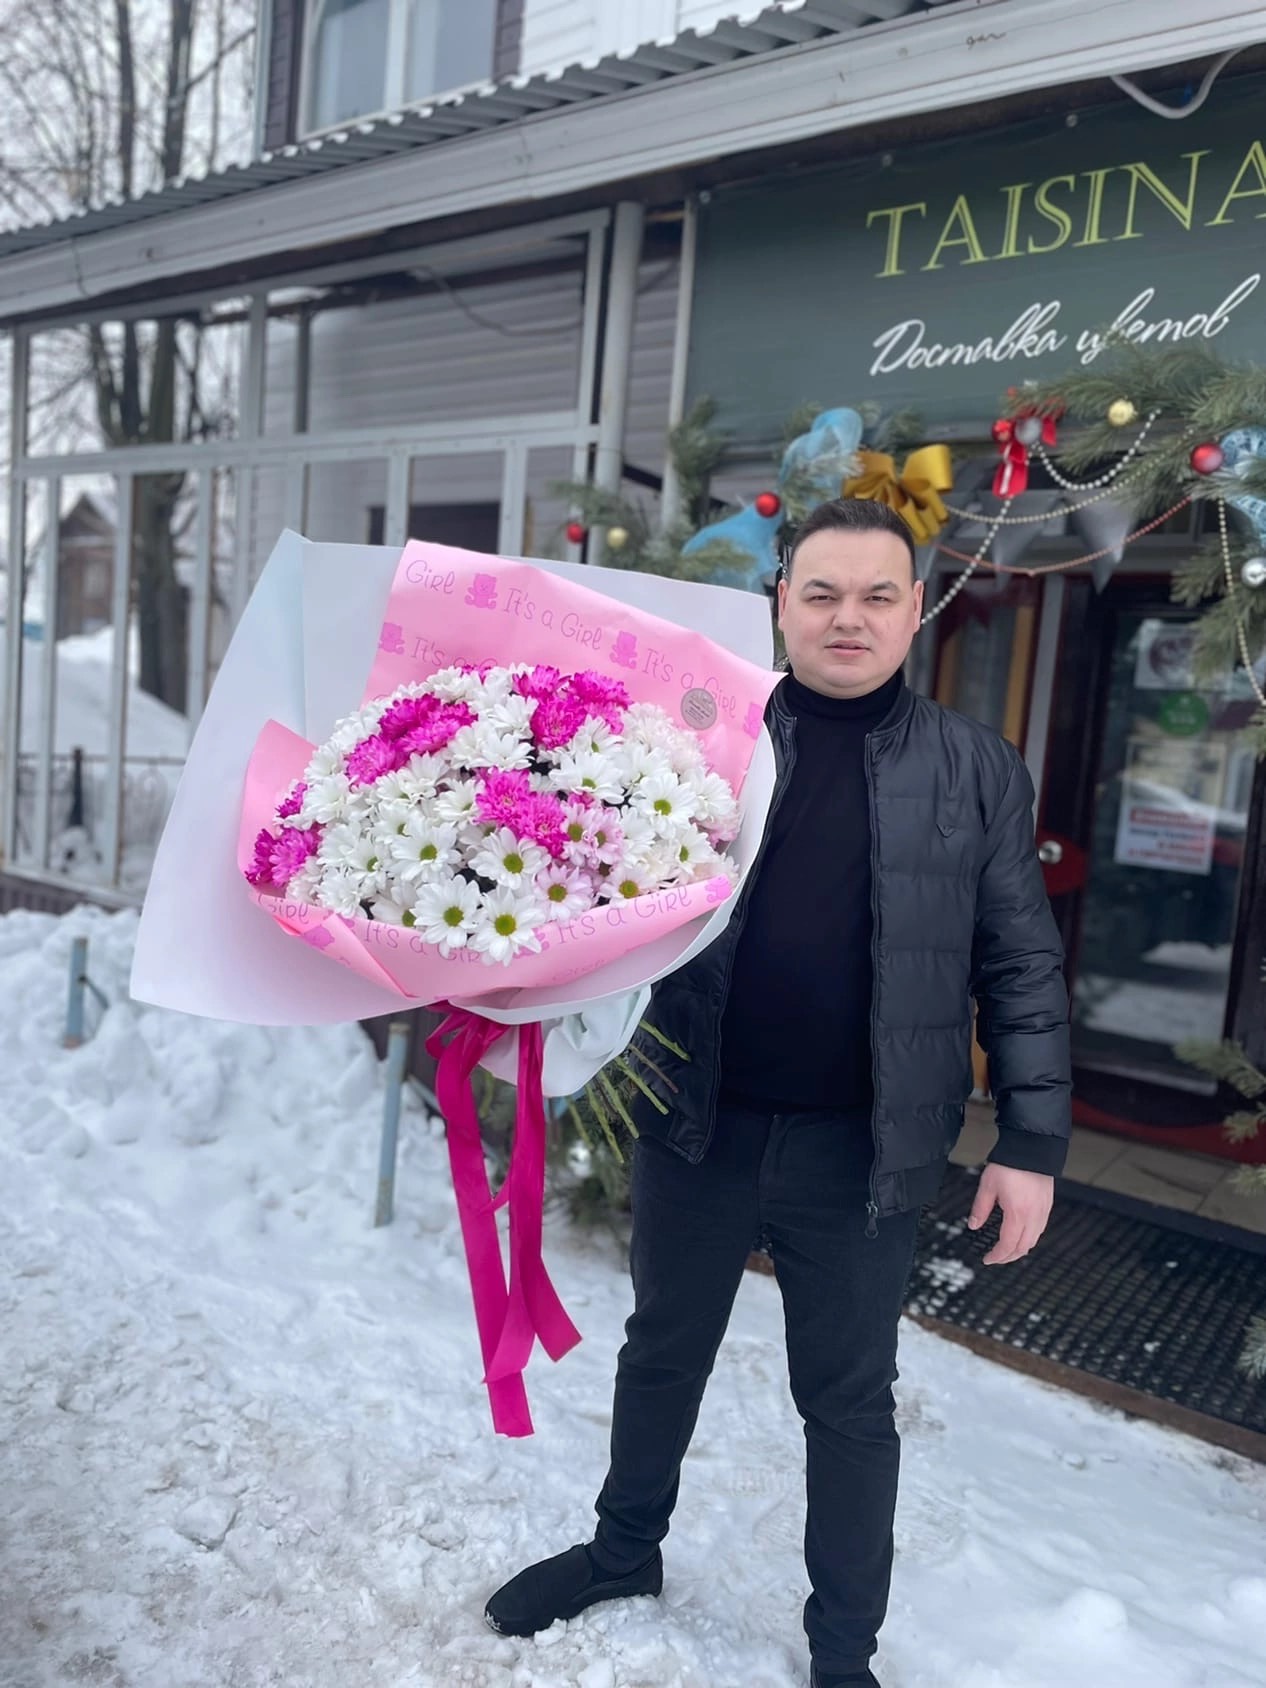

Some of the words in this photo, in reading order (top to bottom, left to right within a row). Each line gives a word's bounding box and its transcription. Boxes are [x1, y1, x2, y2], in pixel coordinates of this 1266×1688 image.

[866, 139, 1266, 278] TAISINA
[869, 300, 1068, 376] Доставка
[1075, 273, 1261, 366] цветов
[406, 559, 456, 595] Girl
[503, 591, 536, 620] It's
[541, 609, 554, 630] a
[560, 612, 602, 650] Girl
[410, 636, 446, 667] It's
[641, 648, 674, 682] It's
[364, 920, 400, 949] It's
[558, 917, 596, 944] It's
[606, 907, 627, 927] a
[633, 884, 693, 919] Girl
